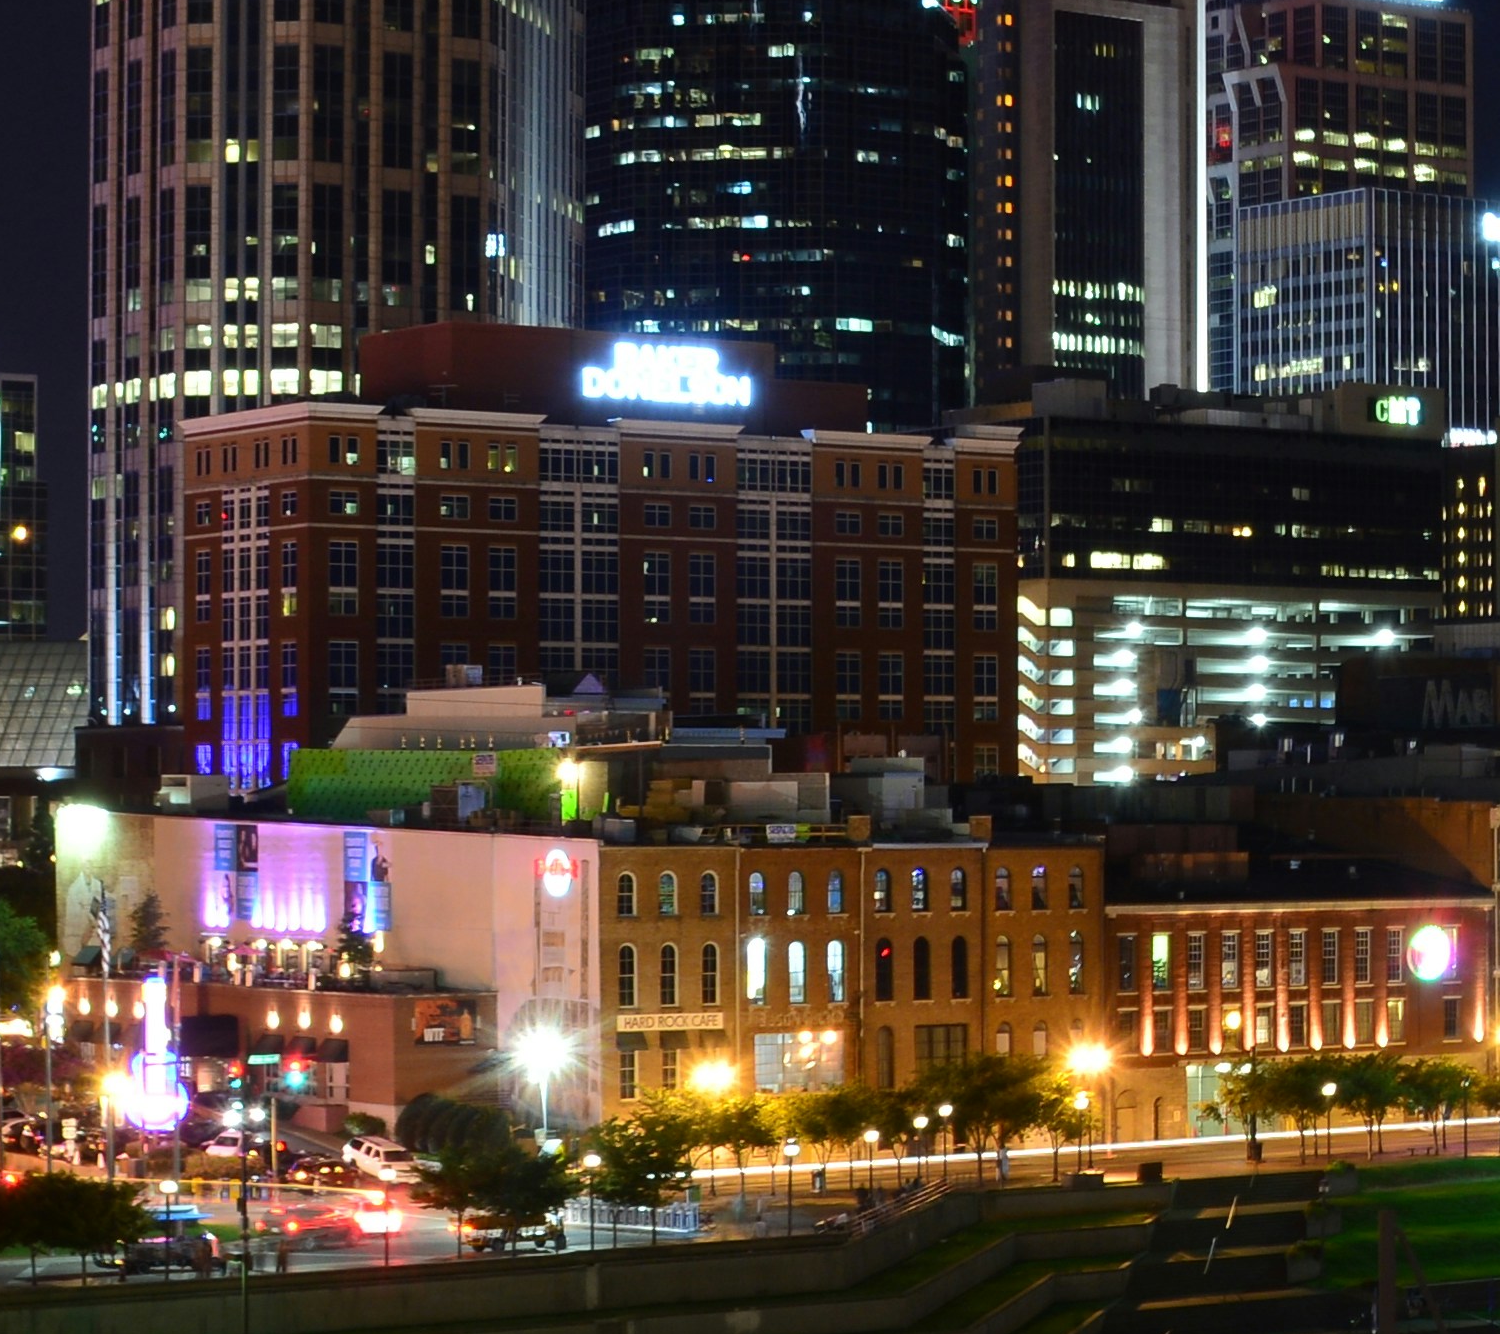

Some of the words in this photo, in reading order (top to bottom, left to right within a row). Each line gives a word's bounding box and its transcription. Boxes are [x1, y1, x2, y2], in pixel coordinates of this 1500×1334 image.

[624, 1017, 654, 1029] HARD
[658, 1015, 688, 1027] ROCK
[692, 1014, 718, 1027] CAFE
